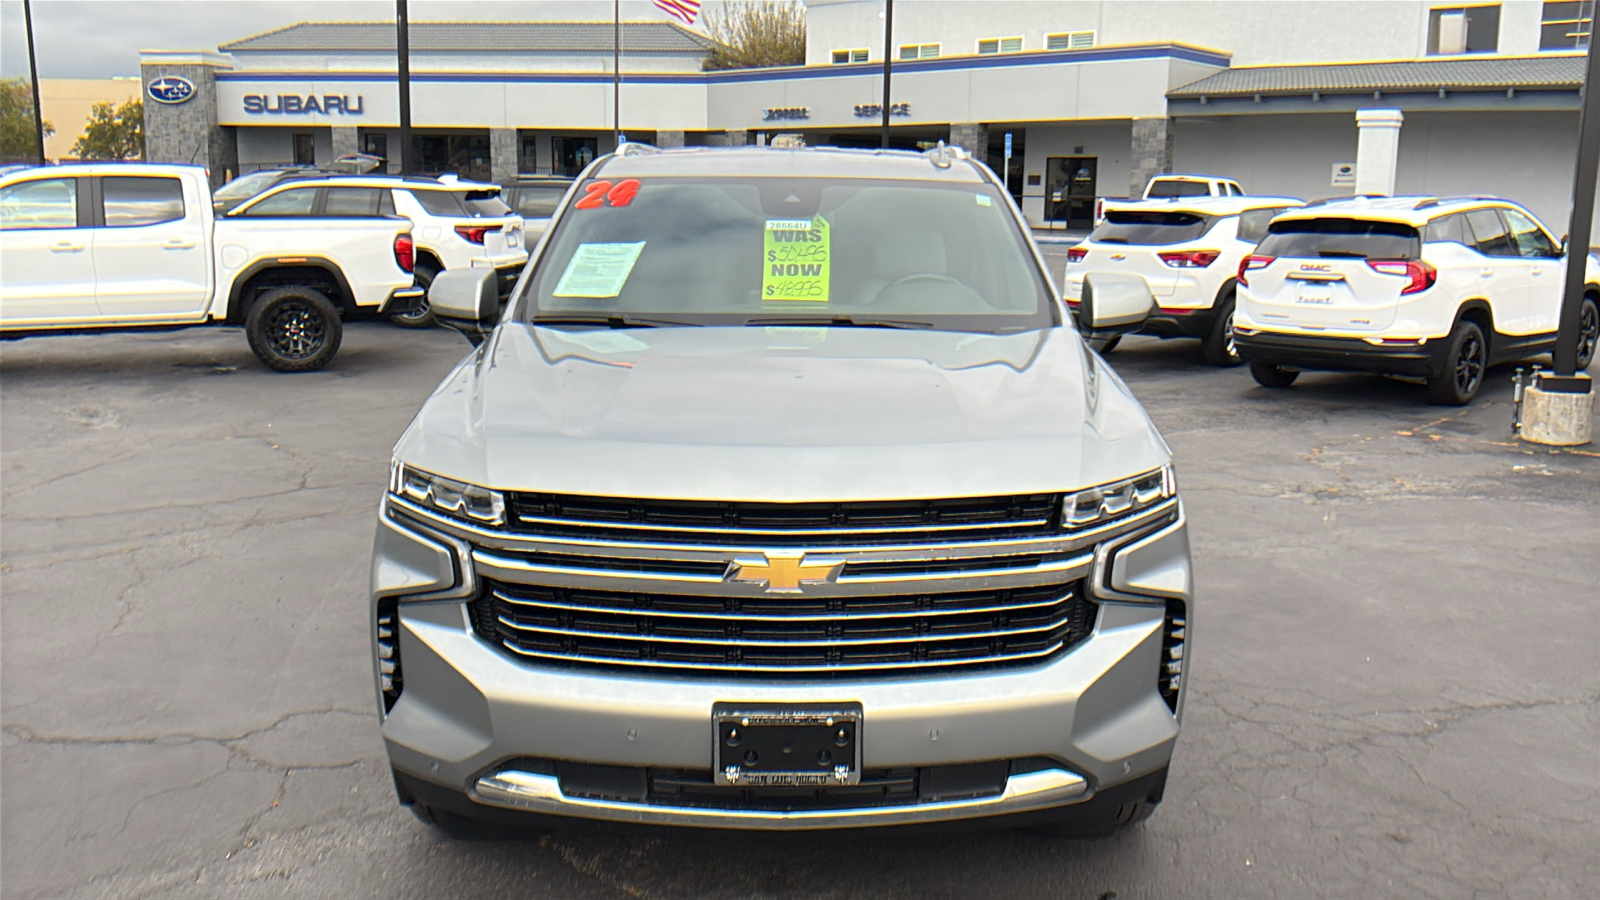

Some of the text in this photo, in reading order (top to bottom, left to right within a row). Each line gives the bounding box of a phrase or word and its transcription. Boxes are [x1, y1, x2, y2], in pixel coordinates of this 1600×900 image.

[243, 94, 364, 115] SUBARU
[853, 103, 911, 118] SERVCE
[574, 178, 641, 210] 24
[769, 221, 808, 230] 28664U
[772, 228, 822, 243] WAS
[771, 263, 823, 277] NOW
[1300, 264, 1331, 272] GMC
